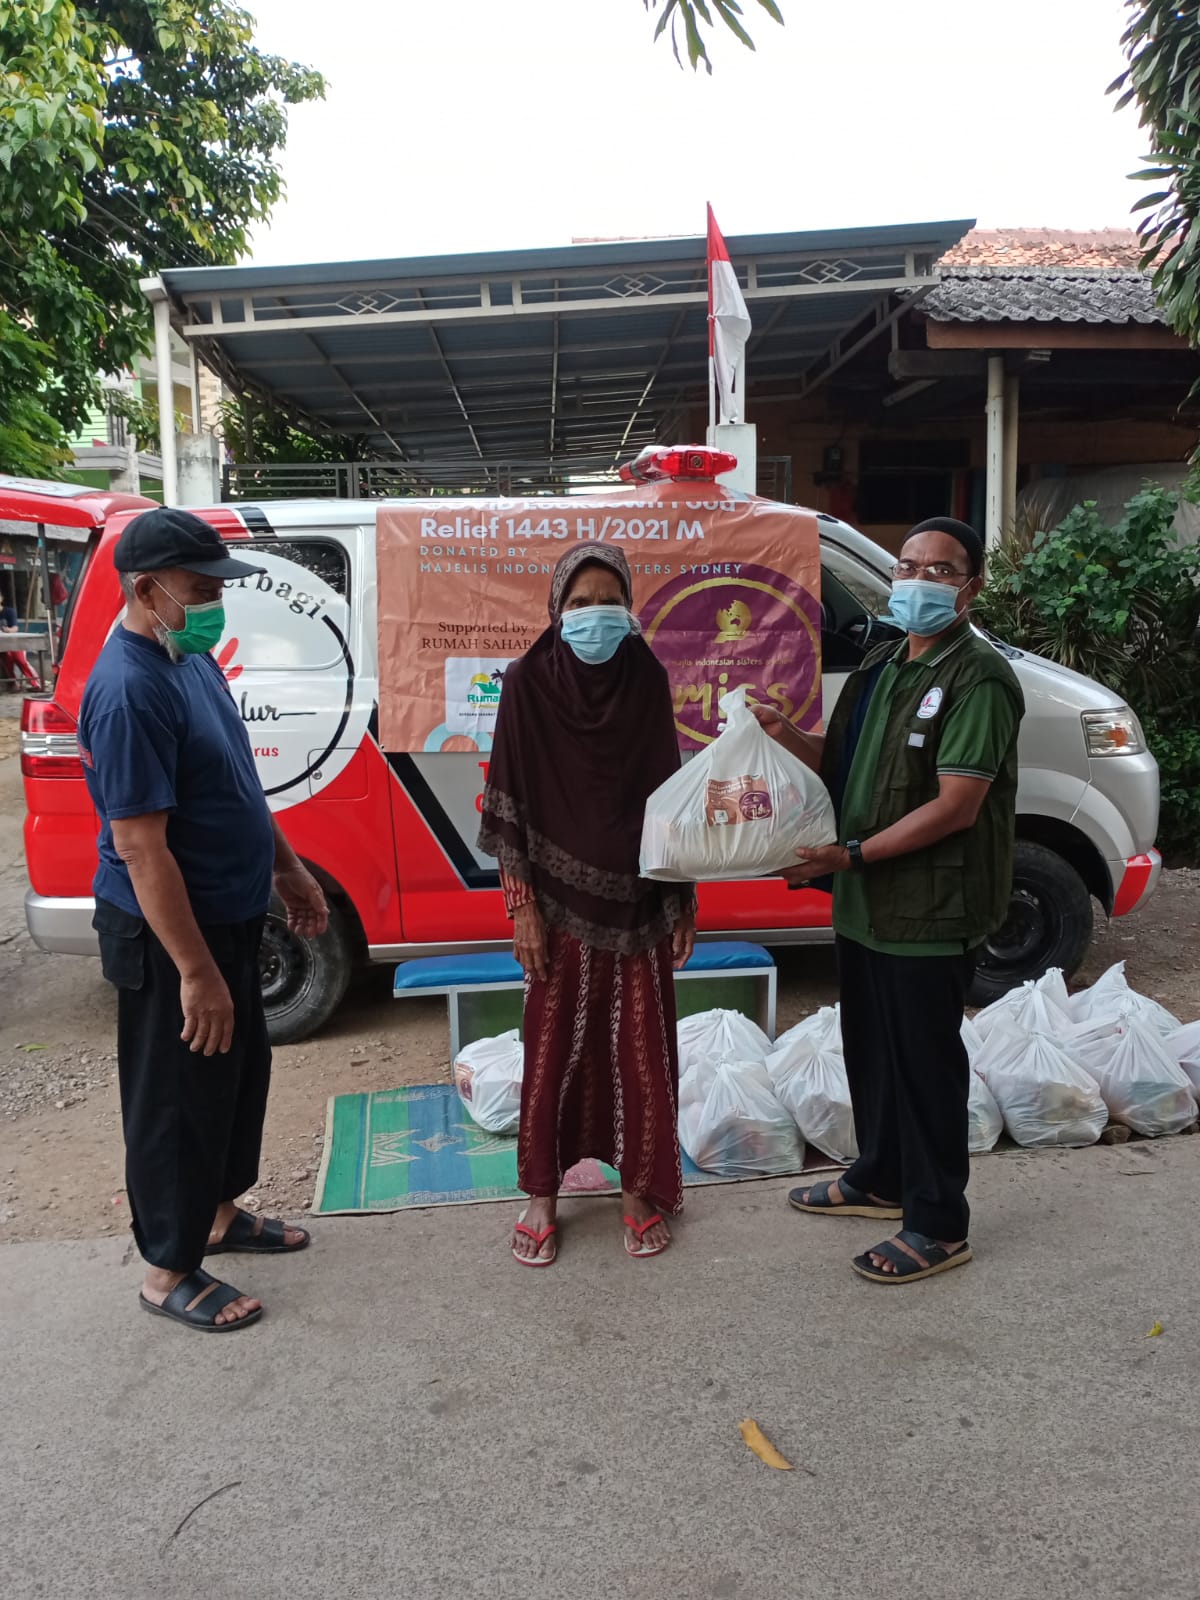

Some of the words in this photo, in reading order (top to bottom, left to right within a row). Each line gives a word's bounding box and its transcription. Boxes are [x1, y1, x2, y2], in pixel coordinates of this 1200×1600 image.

[421, 517, 499, 538] Relief
[506, 518, 568, 539] 1443
[576, 515, 669, 542] H/2021
[675, 519, 705, 541] M
[419, 545, 499, 557] DONATED
[507, 548, 528, 557] BY
[420, 563, 487, 574] MAJELIS
[496, 563, 556, 574] INDON
[628, 564, 671, 574] TERS
[680, 564, 742, 575] SYDNEY
[438, 621, 508, 636] Supported
[511, 622, 528, 635] by
[422, 638, 479, 650] RUMAH
[695, 657, 734, 667] indonesian
[467, 694, 501, 704] Ruma
[254, 746, 280, 758] rus
